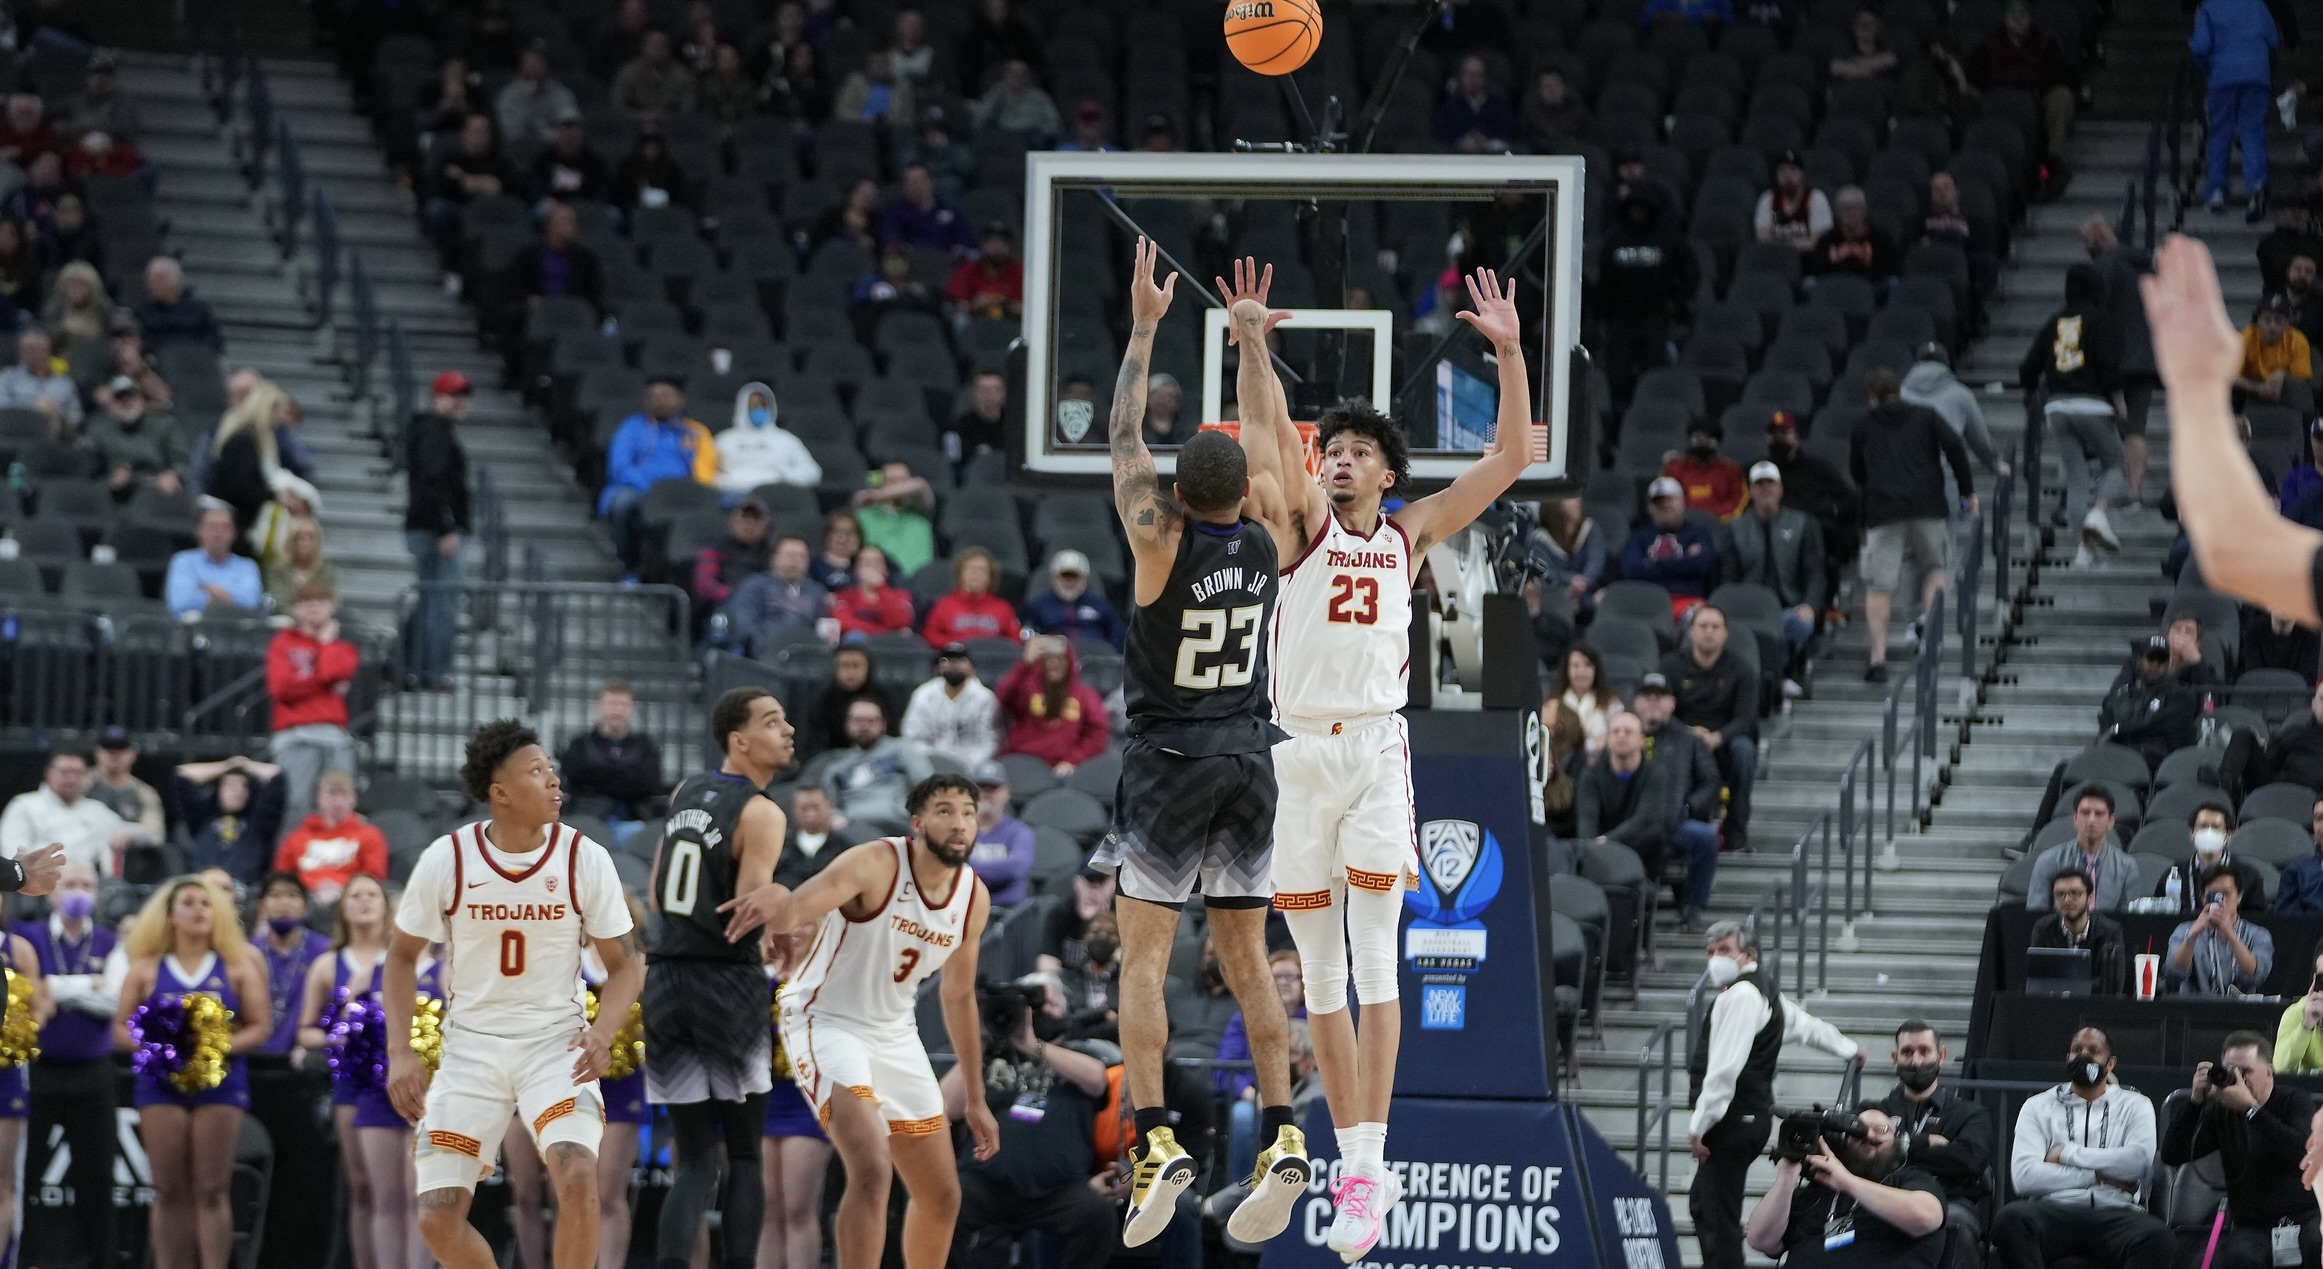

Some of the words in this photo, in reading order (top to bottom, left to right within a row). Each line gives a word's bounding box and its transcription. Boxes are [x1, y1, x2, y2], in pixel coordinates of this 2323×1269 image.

[1228, 540, 1241, 554] W
[1191, 567, 1243, 603] BROWN
[1247, 571, 1268, 596] JR
[1328, 574, 1379, 625] 23
[1173, 602, 1264, 689] 23
[1424, 822, 1478, 866] PAC
[664, 840, 702, 916] 0
[1440, 858, 1460, 877] 12
[467, 904, 566, 920] TROJANS
[891, 914, 954, 947] TROJANS
[500, 929, 526, 977] 0
[893, 947, 920, 983] 3
[1416, 957, 1436, 968] LAS
[1440, 957, 1473, 968] VEGAS
[1421, 973, 1457, 983] presented
[1457, 974, 1467, 984] by
[1428, 989, 1460, 1001] NEW
[1425, 1000, 1462, 1012] YORK
[1427, 1011, 1458, 1023] LIFE
[1307, 1158, 1511, 1201] COERENCE
[1521, 1165, 1563, 1203] OF
[1304, 1197, 1561, 1256] CMPIONS
